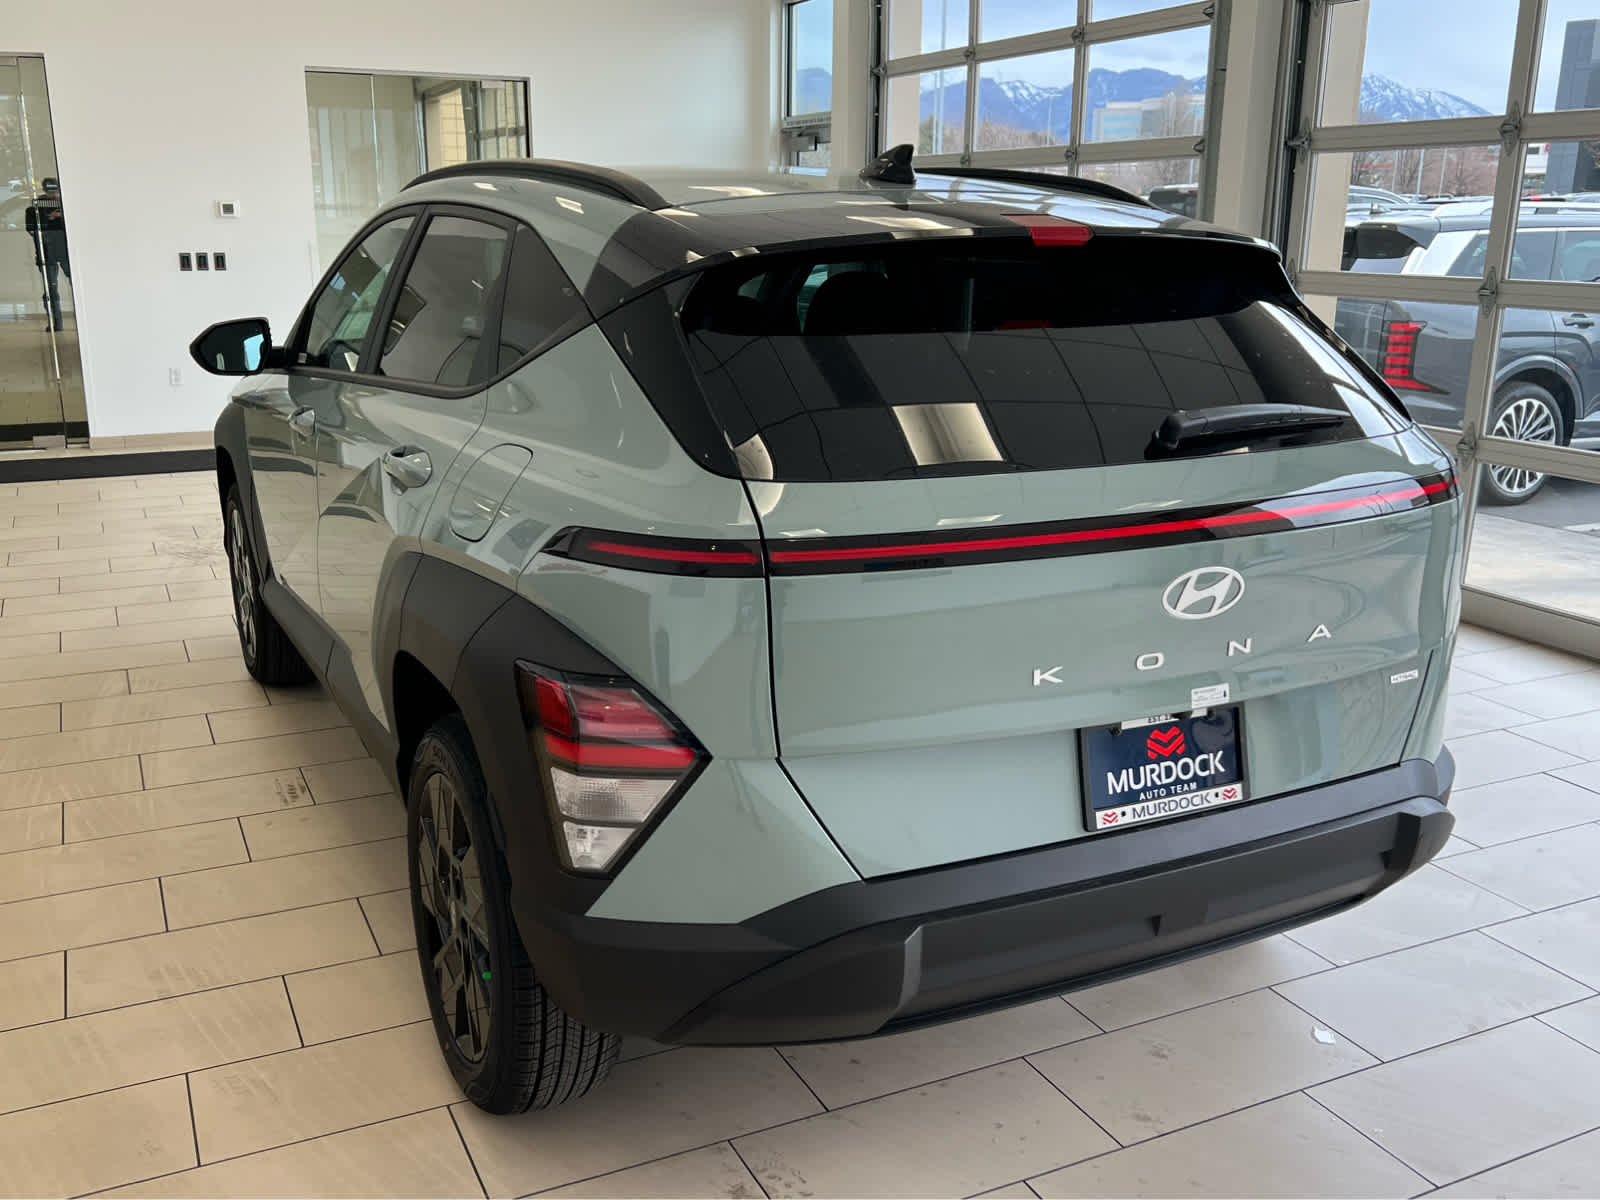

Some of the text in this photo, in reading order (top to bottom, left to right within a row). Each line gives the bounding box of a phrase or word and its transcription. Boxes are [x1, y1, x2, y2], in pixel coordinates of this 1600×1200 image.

[1032, 623, 1332, 686] KONA
[1106, 750, 1226, 795] MURDOCK
[1139, 781, 1198, 801] AUTO TEAM
[1131, 791, 1211, 820] MURDOCK
